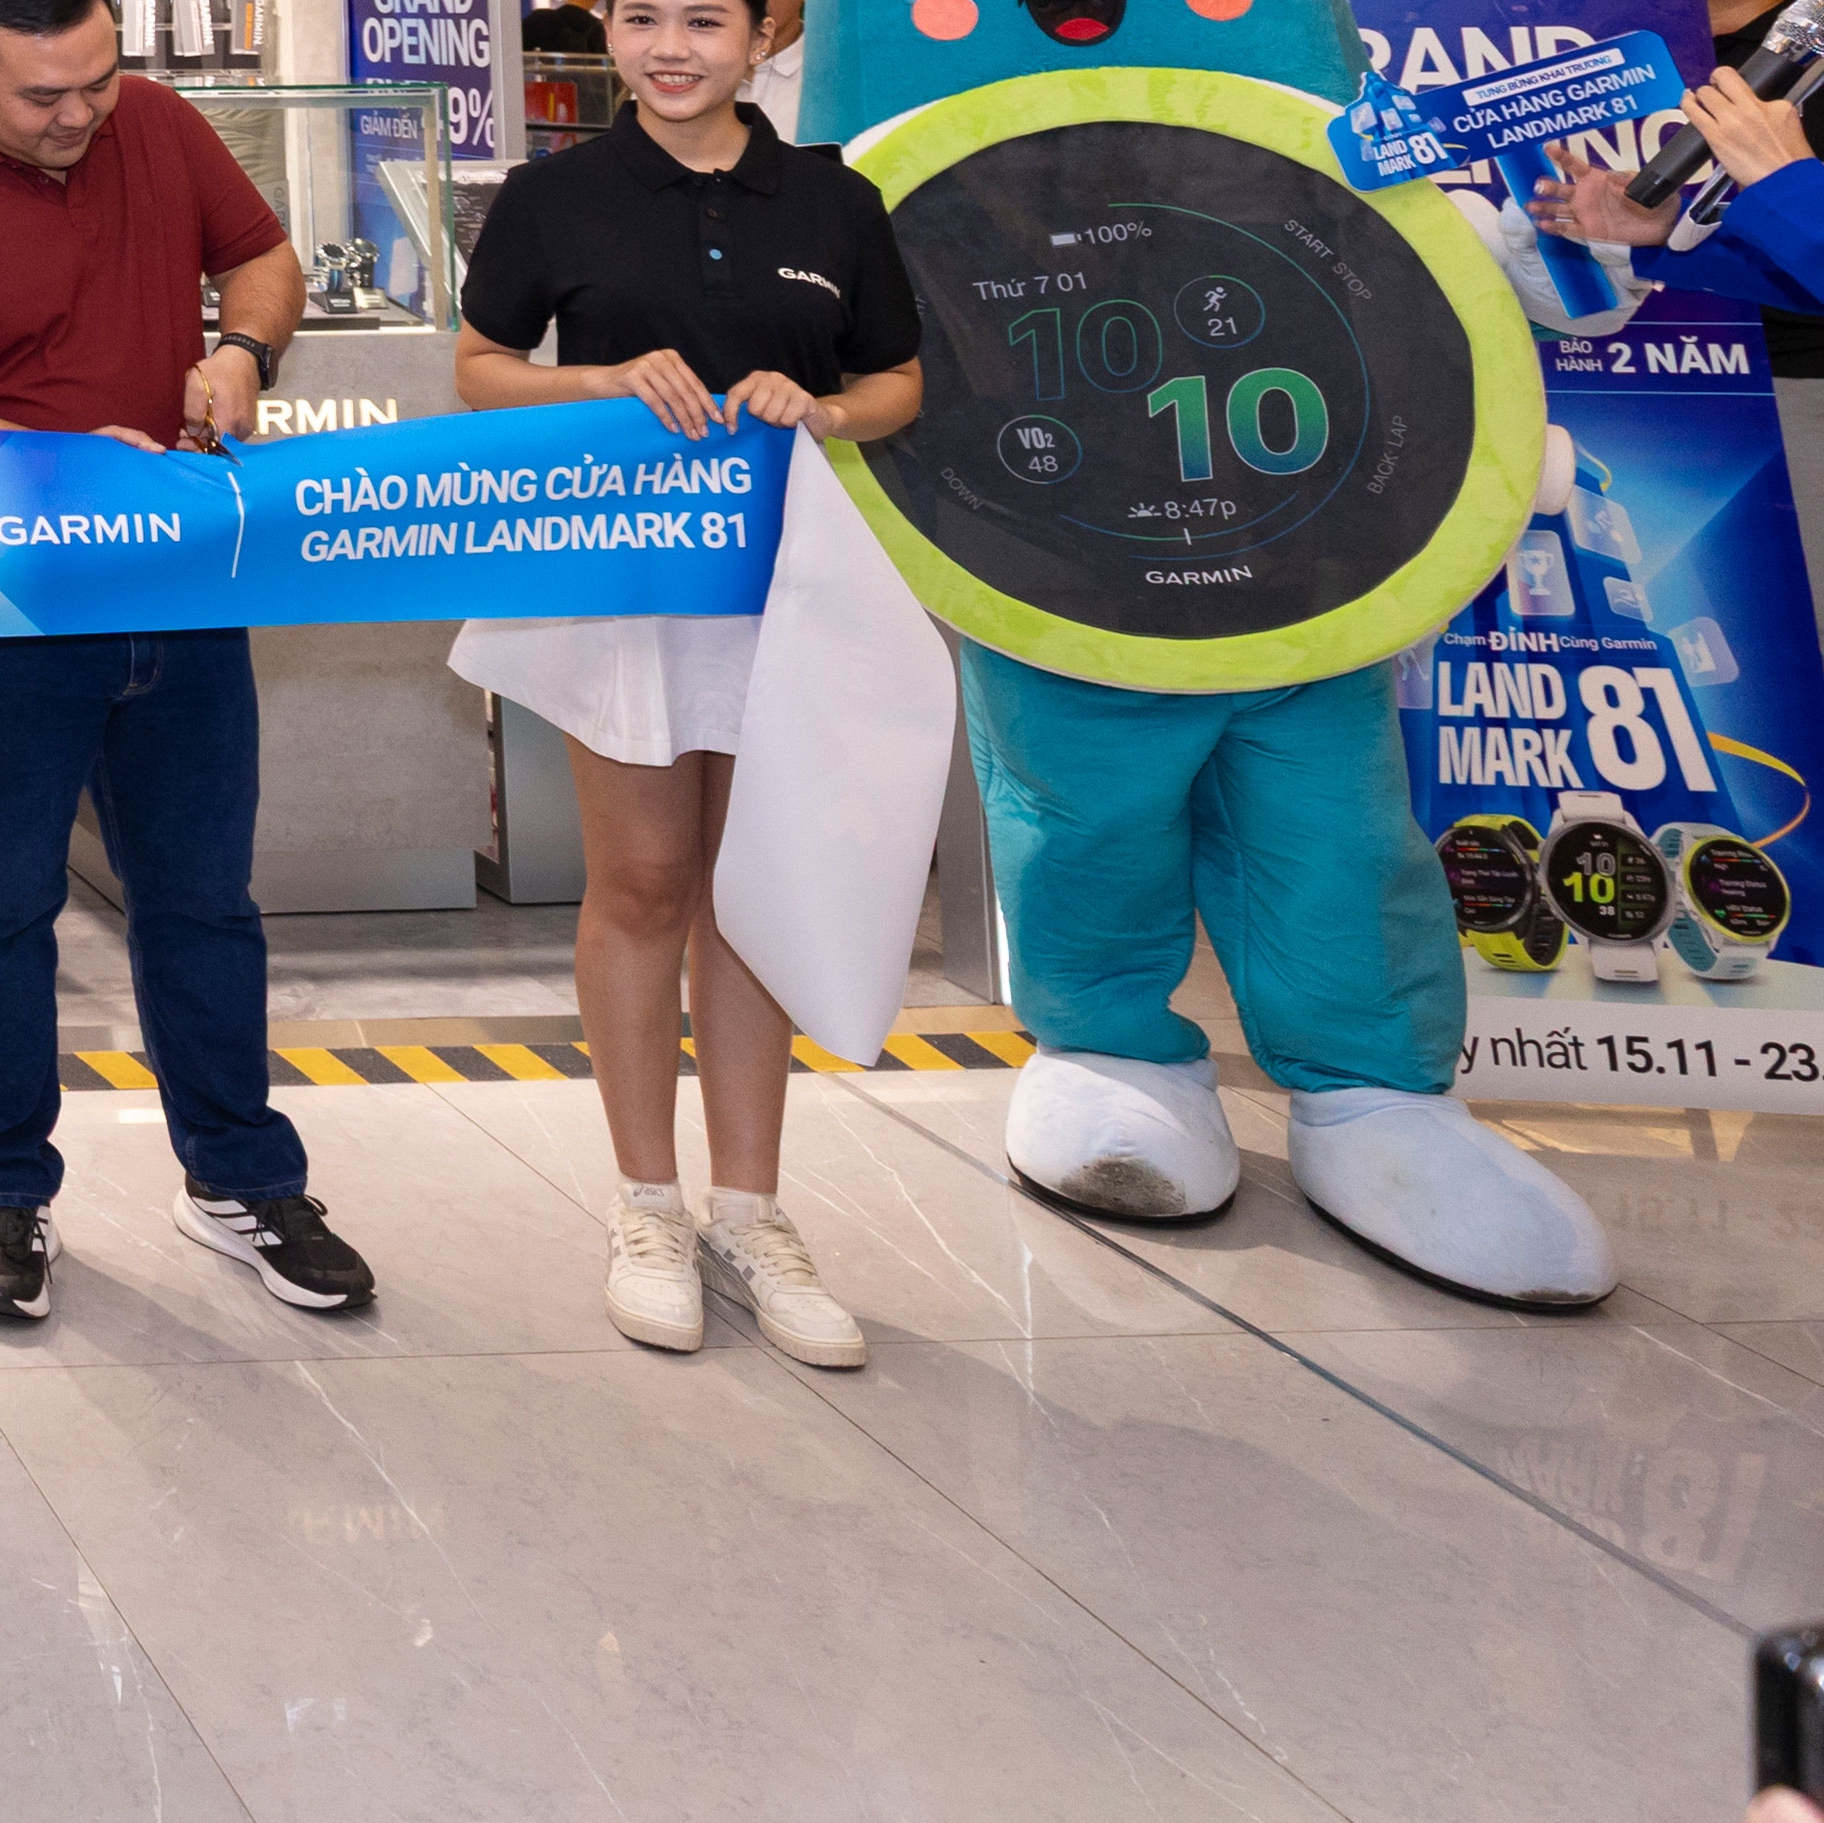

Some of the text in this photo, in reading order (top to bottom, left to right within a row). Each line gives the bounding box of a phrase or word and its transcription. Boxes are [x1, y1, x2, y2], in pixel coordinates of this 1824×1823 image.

[362, 17, 491, 68] OPENING
[1540, 67, 1566, 82] KHAI
[1453, 63, 1657, 133] CỬA HÀNG GARMIN
[360, 110, 418, 140] GIẢM ĐẾN
[1487, 100, 1613, 150] LANDMARK
[1611, 94, 1639, 115] 81
[1373, 131, 1448, 165] LAND 81
[1377, 153, 1417, 177] MARK
[1083, 221, 1153, 246] 100%
[1284, 217, 1373, 303] START STOP
[777, 267, 841, 300] GARMIN
[973, 271, 1088, 302] Thứ 7 01
[1207, 316, 1238, 338] 21
[1007, 298, 1164, 402] 10
[1559, 337, 1593, 354] BẢO
[1606, 334, 1751, 375] 2 NĂM
[1555, 355, 1604, 373] HÀNH
[1146, 366, 1330, 483] 10
[1027, 454, 1059, 475] 48
[1367, 414, 1409, 496] BACK LAP
[294, 453, 753, 517] CHÀO MỪNG CỬA HÀNG
[940, 466, 983, 512] DOWN
[1164, 497, 1237, 522] 8:47p
[300, 511, 747, 563] GARMIN LANDMARK 81
[1144, 564, 1253, 587] GARMIN
[1443, 626, 1658, 653] Chạm ĐỈNH Cùng Garmin
[1437, 661, 1568, 721] LAND
[1577, 664, 1718, 793] 81
[1438, 725, 1585, 790] MARK
[1576, 851, 1616, 876] 10
[1562, 871, 1615, 904] 10
[1599, 905, 1615, 916] 38
[1490, 1026, 1588, 1071] nhất
[1596, 1034, 1718, 1077] 15.11
[1734, 1057, 1751, 1067] -
